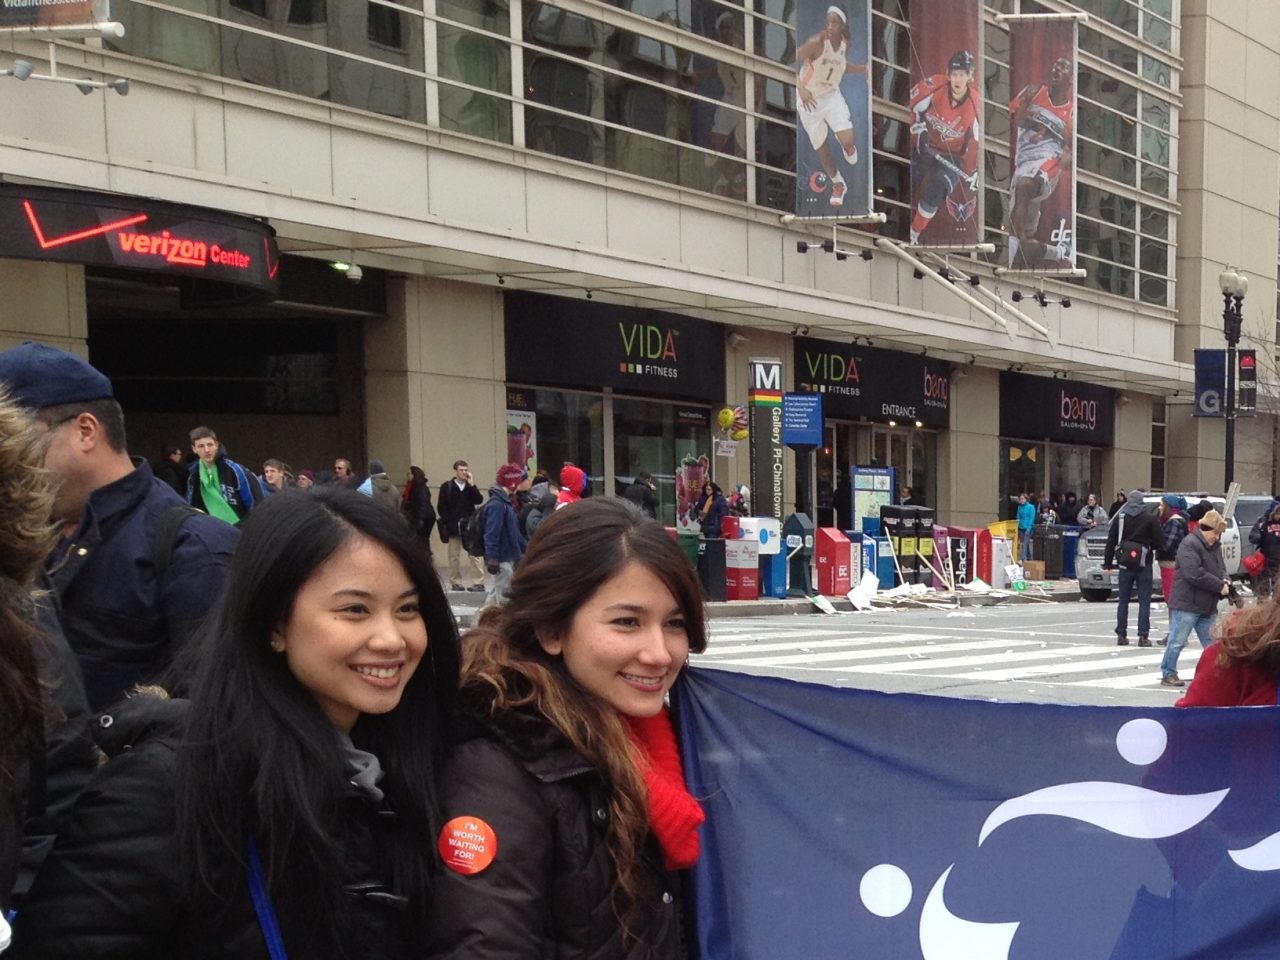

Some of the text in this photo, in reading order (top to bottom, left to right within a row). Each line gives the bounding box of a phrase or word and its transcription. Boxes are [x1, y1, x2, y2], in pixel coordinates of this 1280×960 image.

[118, 231, 251, 268] verizon Center
[619, 322, 678, 362] VIDA
[645, 365, 678, 378] FITNESS
[755, 363, 780, 390] M
[805, 352, 860, 382] VIDA
[828, 386, 861, 397] FITNESS
[1199, 390, 1220, 413] G
[882, 403, 916, 419] ENTRANCE
[1061, 389, 1096, 430] bang
[771, 407, 782, 445] Gallery
[955, 538, 967, 587] blade
[1223, 546, 1236, 560] ICE
[453, 829, 486, 843] WORTH
[464, 822, 478, 831] I'M
[448, 838, 485, 853] WAITING
